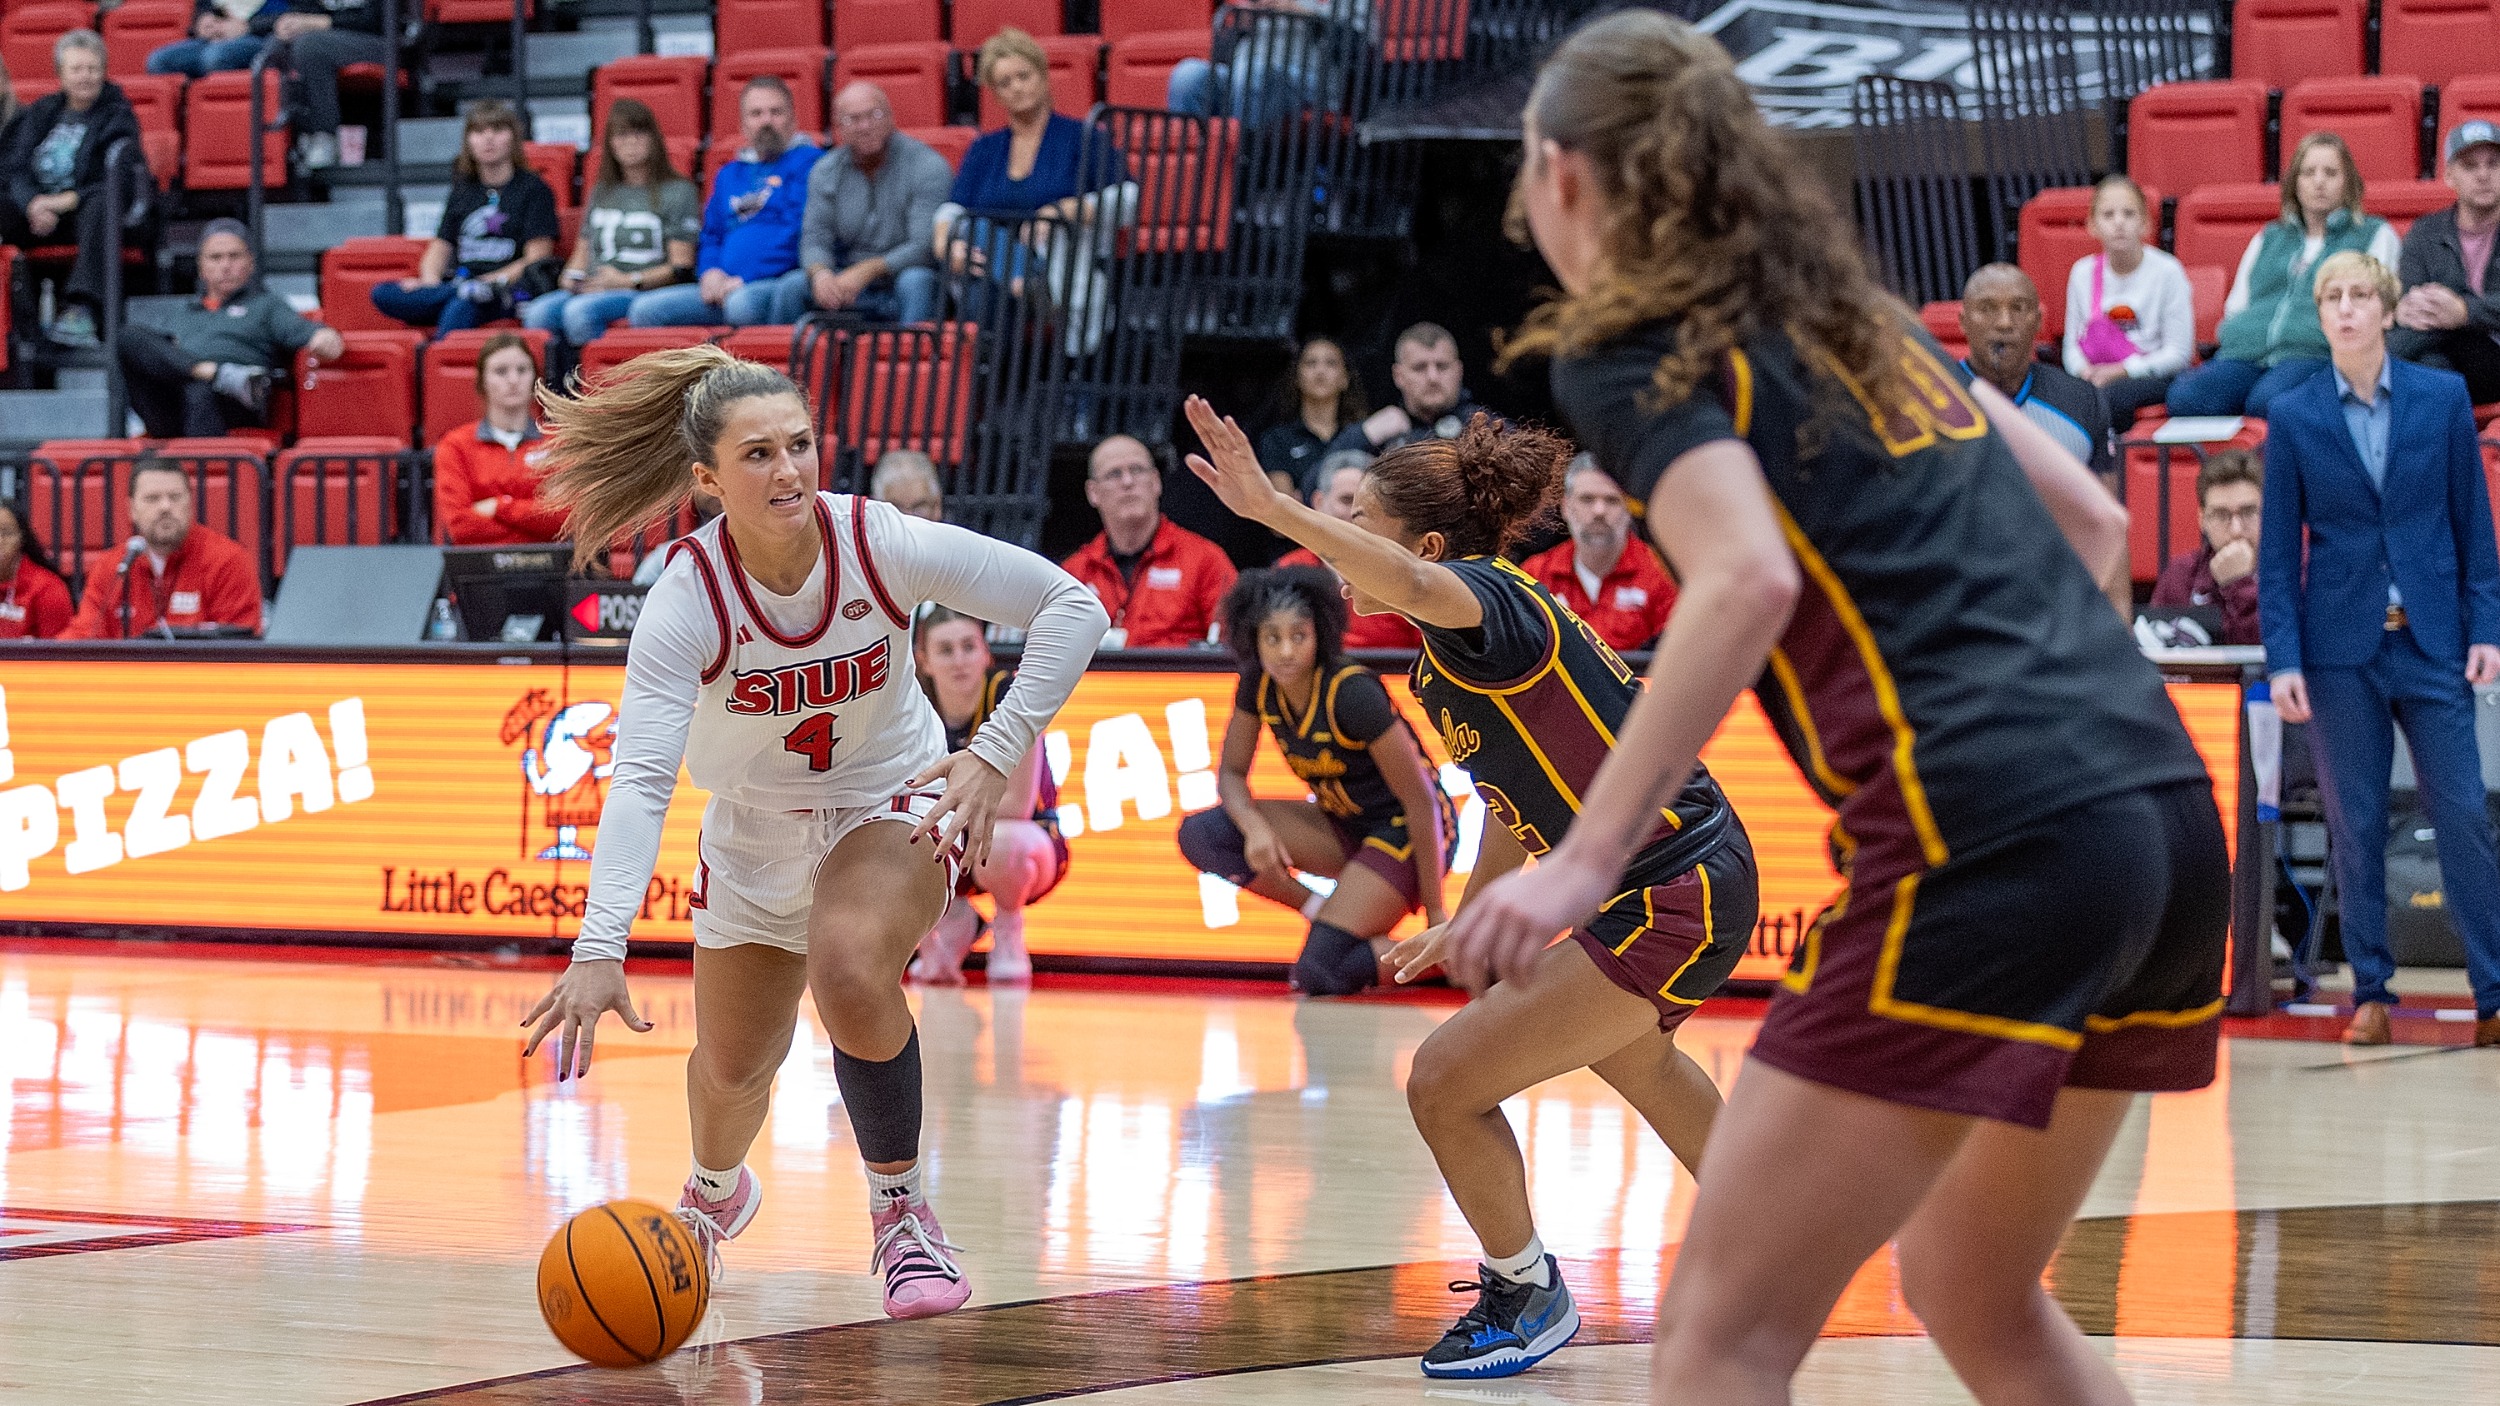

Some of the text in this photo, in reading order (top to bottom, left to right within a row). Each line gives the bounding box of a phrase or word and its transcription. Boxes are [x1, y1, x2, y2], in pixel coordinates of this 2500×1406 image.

[599, 593, 647, 631] POS
[726, 635, 891, 716] SIUE
[782, 711, 843, 772] 4
[0, 697, 374, 892] PIZZA!
[380, 867, 476, 914] Little
[484, 869, 588, 918] Caesa
